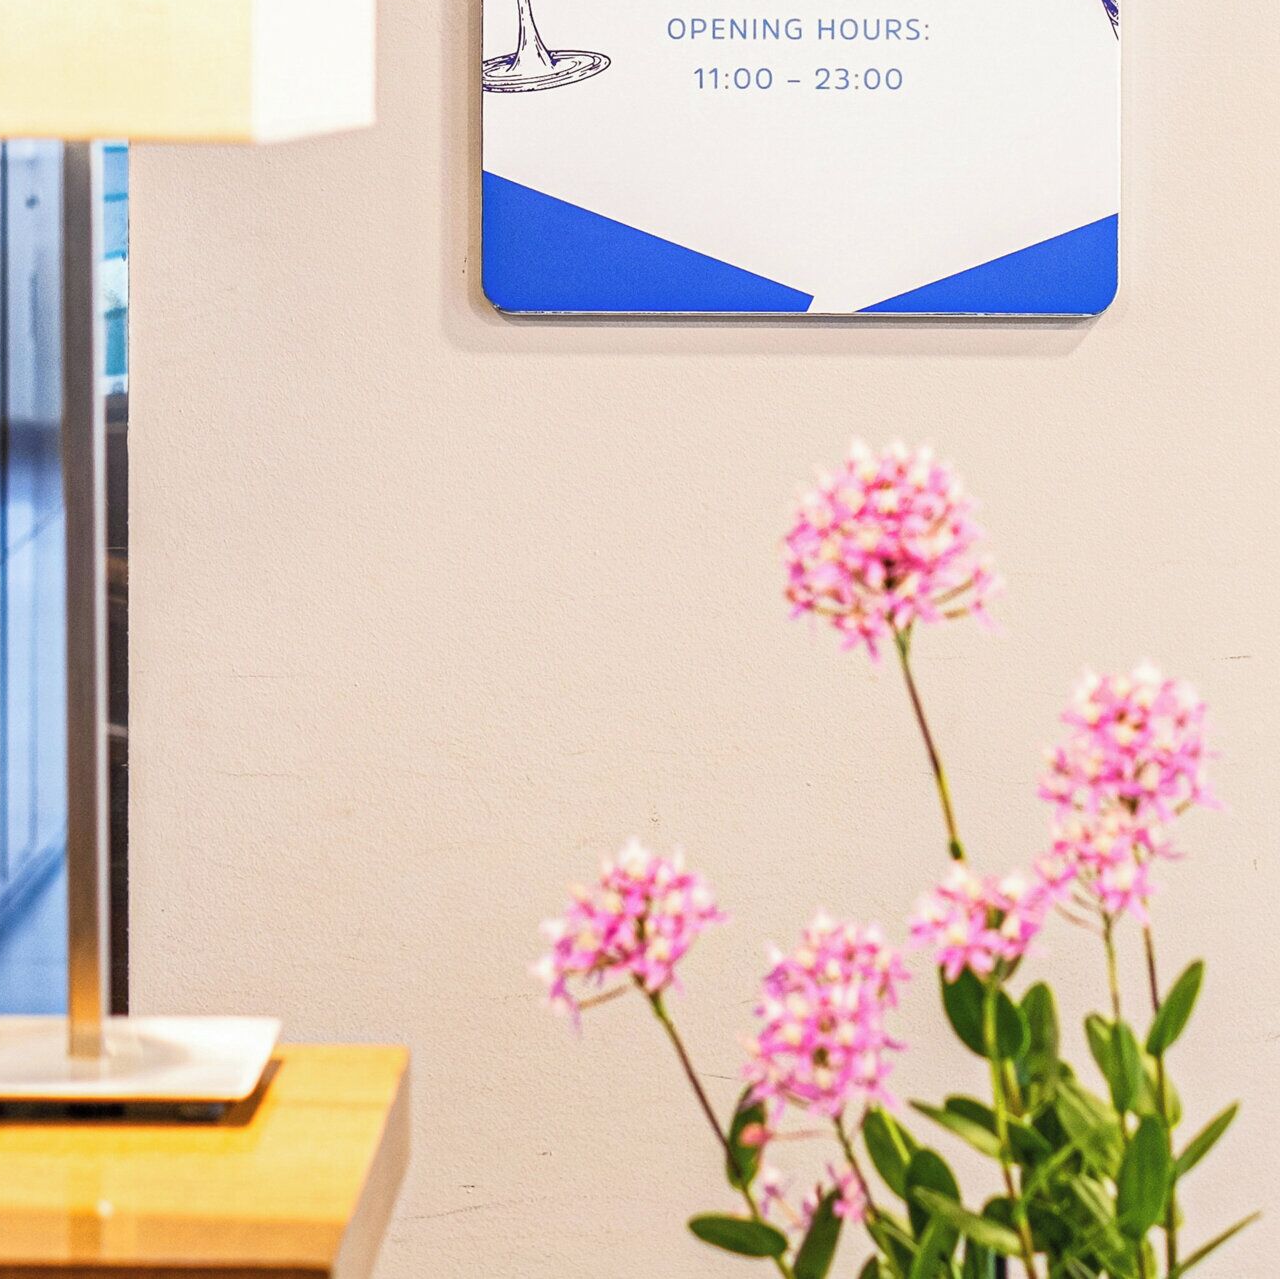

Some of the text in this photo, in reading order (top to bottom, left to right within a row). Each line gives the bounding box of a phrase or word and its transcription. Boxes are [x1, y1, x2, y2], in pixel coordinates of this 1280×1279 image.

[667, 17, 930, 41] OPENING HOURS:
[693, 67, 773, 91] 11:00
[815, 67, 903, 91] 23:00
